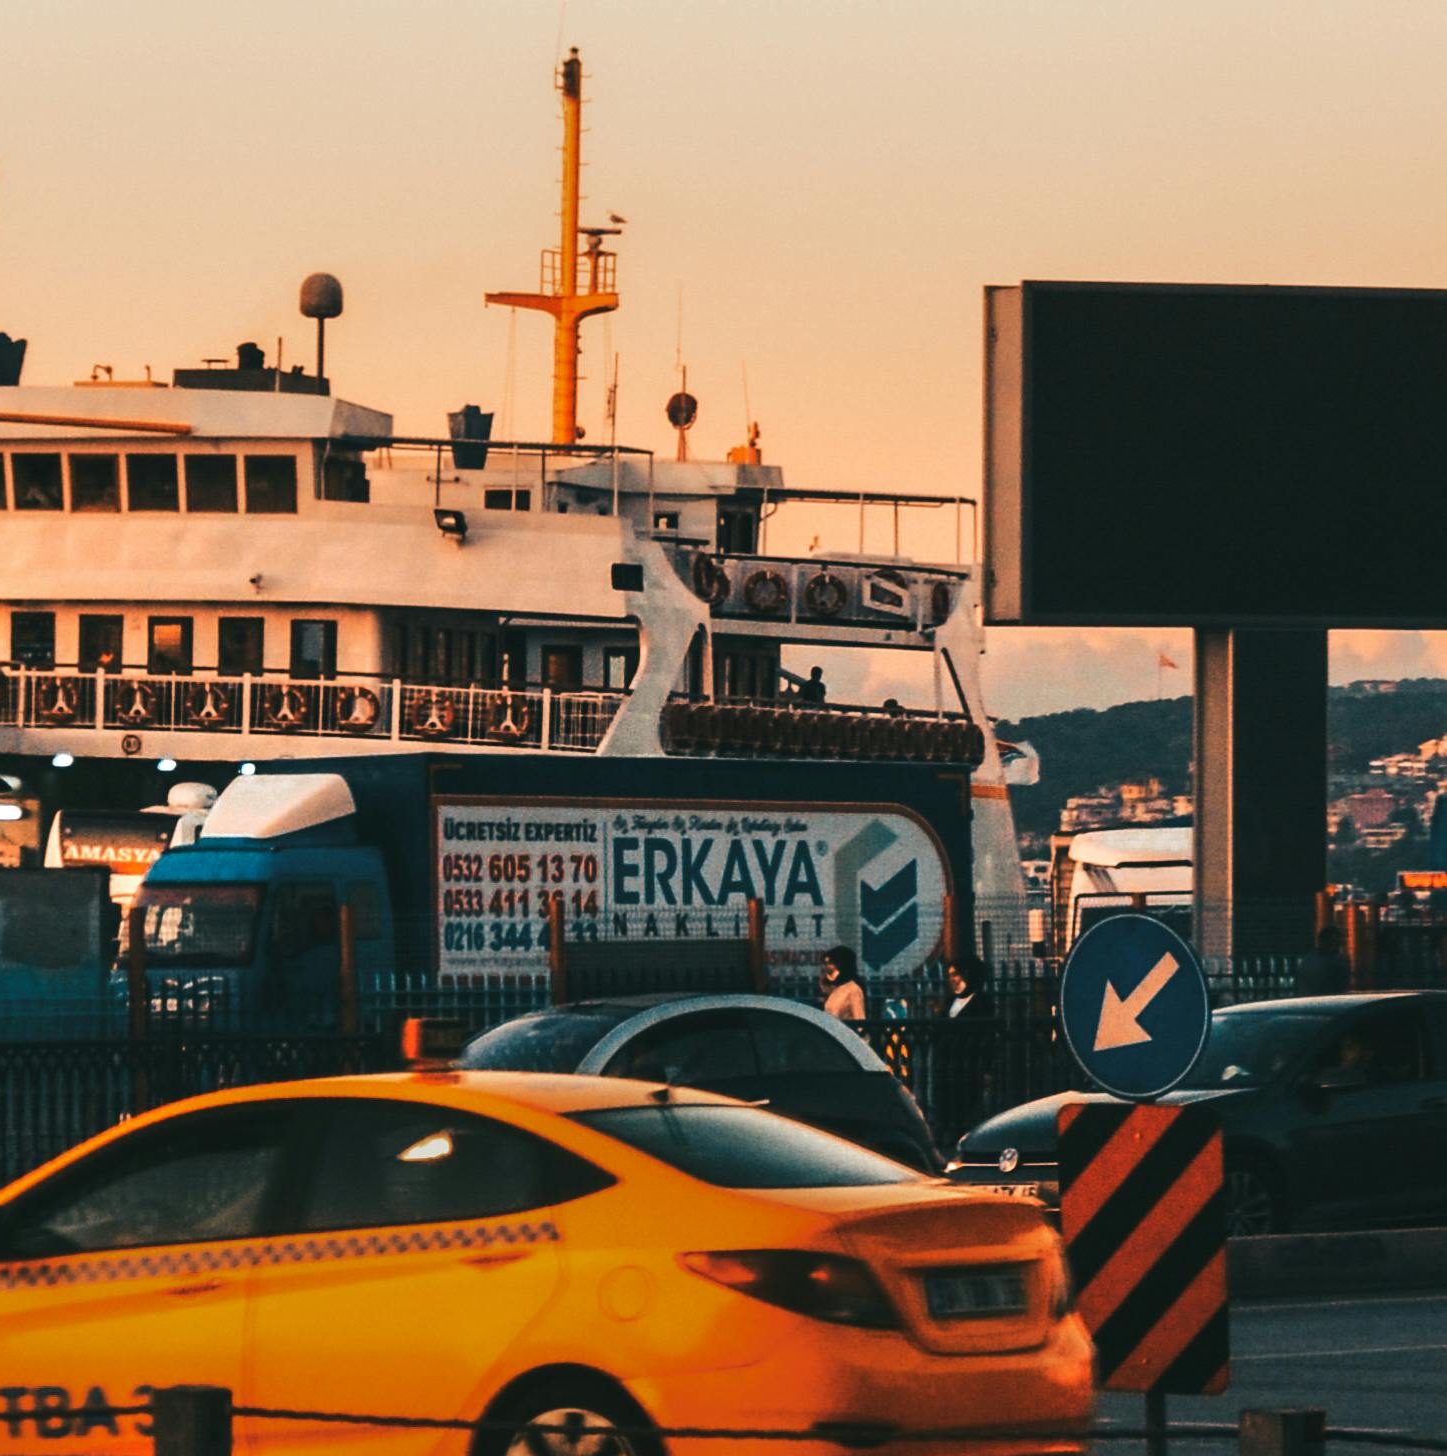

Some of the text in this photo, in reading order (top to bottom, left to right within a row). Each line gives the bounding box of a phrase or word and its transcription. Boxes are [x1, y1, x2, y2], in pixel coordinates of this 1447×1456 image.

[443, 816, 521, 841] ÜCRETSİZ
[524, 818, 598, 843] EXPERTİZ
[64, 844, 163, 863] AMASYA
[443, 853, 598, 883] 0532 605 13 70
[612, 836, 824, 907] ERKAYA
[443, 888, 484, 918] 0533
[489, 888, 530, 918] 411
[571, 888, 599, 918] 14
[444, 921, 485, 951] 0216
[489, 921, 533, 951] 344
